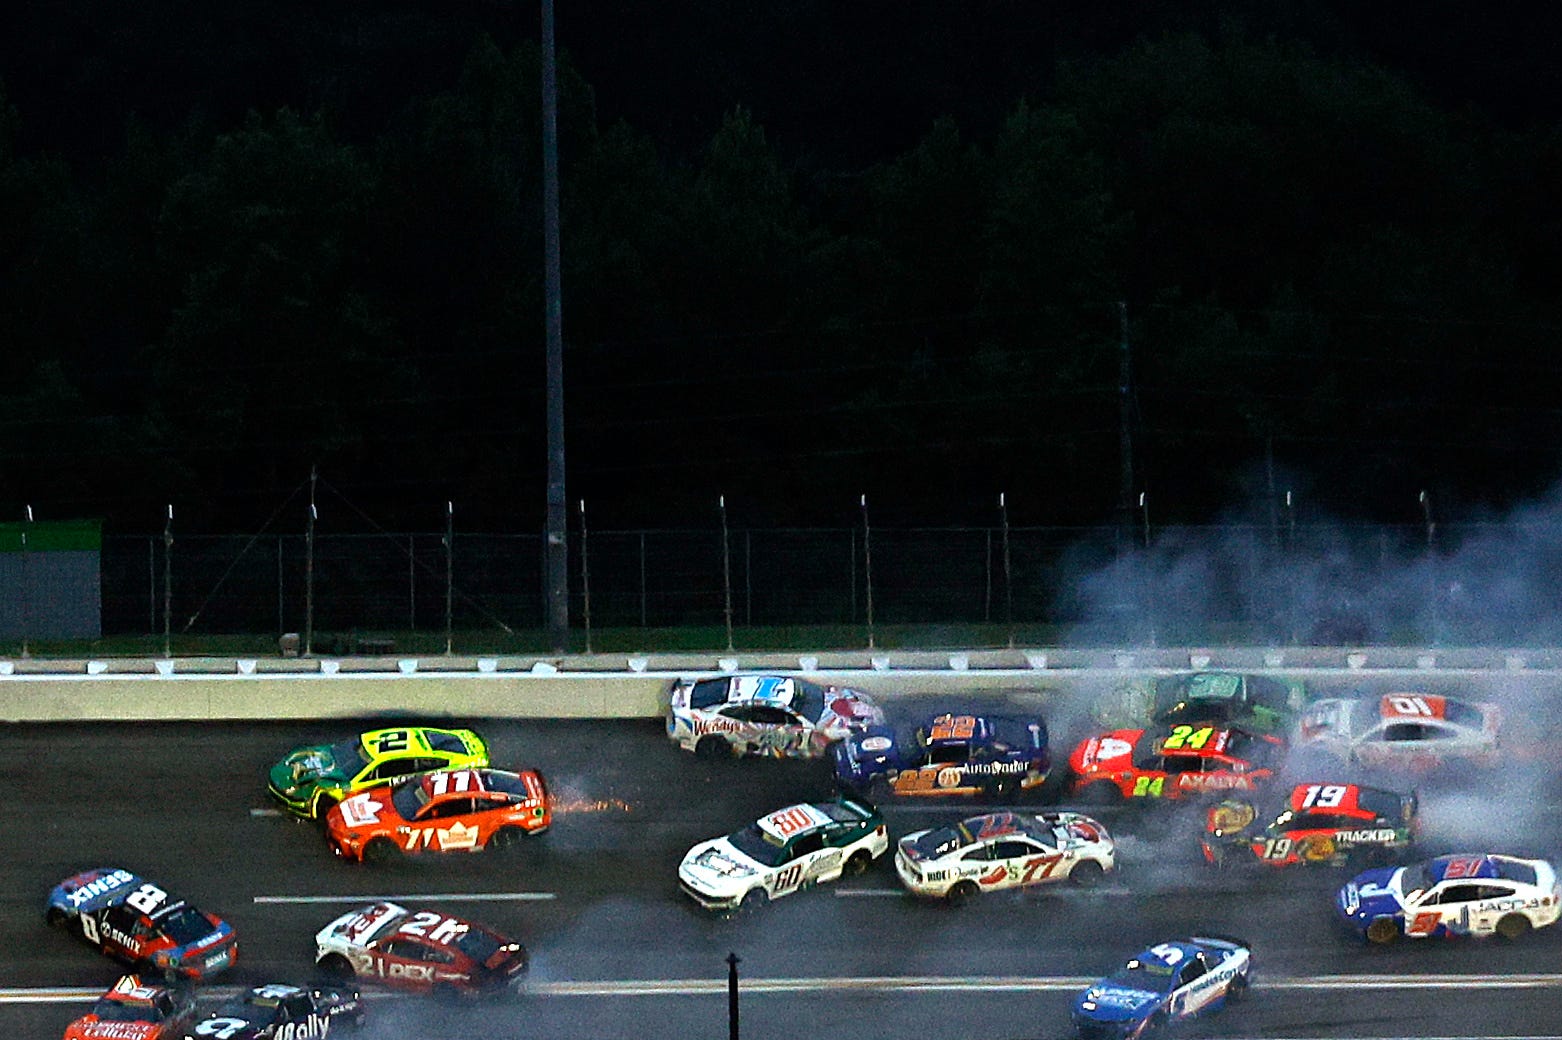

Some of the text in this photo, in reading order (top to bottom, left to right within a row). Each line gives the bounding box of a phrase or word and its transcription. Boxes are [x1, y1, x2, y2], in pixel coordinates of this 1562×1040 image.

[693, 719, 741, 736] Wendy's
[931, 715, 976, 738] 22
[1163, 725, 1213, 749] 24
[1132, 776, 1164, 796] 24
[1177, 773, 1248, 790] AXALTA
[1301, 786, 1347, 808] 19
[1334, 828, 1396, 843] TRACKER
[1262, 838, 1292, 860] 19
[773, 863, 804, 890] 60
[1022, 853, 1065, 883] 77
[1444, 858, 1483, 879] 51
[126, 883, 168, 915] 8
[1408, 912, 1442, 933] 51
[1150, 943, 1184, 966] 5
[359, 955, 385, 978] 21
[297, 1014, 331, 1040] ally
